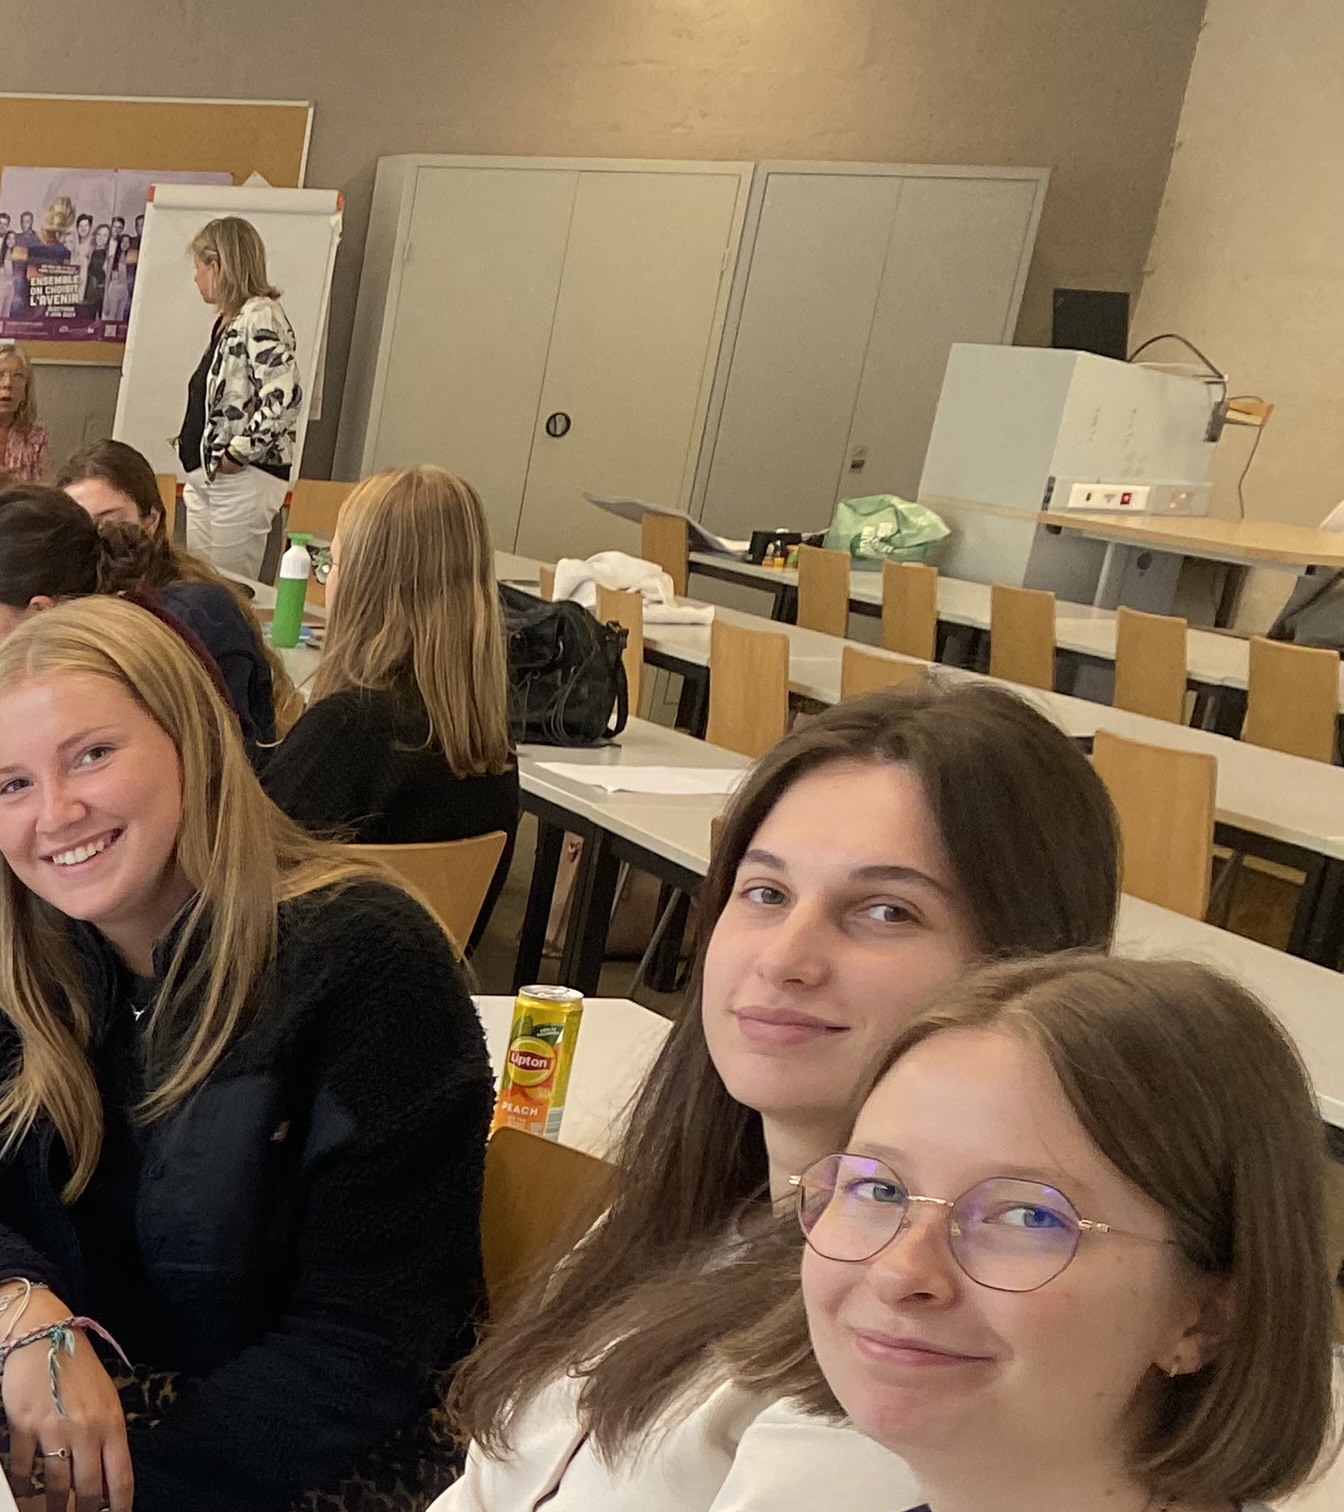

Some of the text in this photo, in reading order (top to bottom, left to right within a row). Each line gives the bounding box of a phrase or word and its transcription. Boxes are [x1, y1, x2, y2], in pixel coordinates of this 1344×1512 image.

[30, 275, 79, 285] ENSEMBLE
[30, 285, 79, 295] ON CHOISIT
[30, 295, 79, 306] L'AVENIR
[511, 1053, 548, 1068] Lipton
[501, 1101, 538, 1116] PEACH
